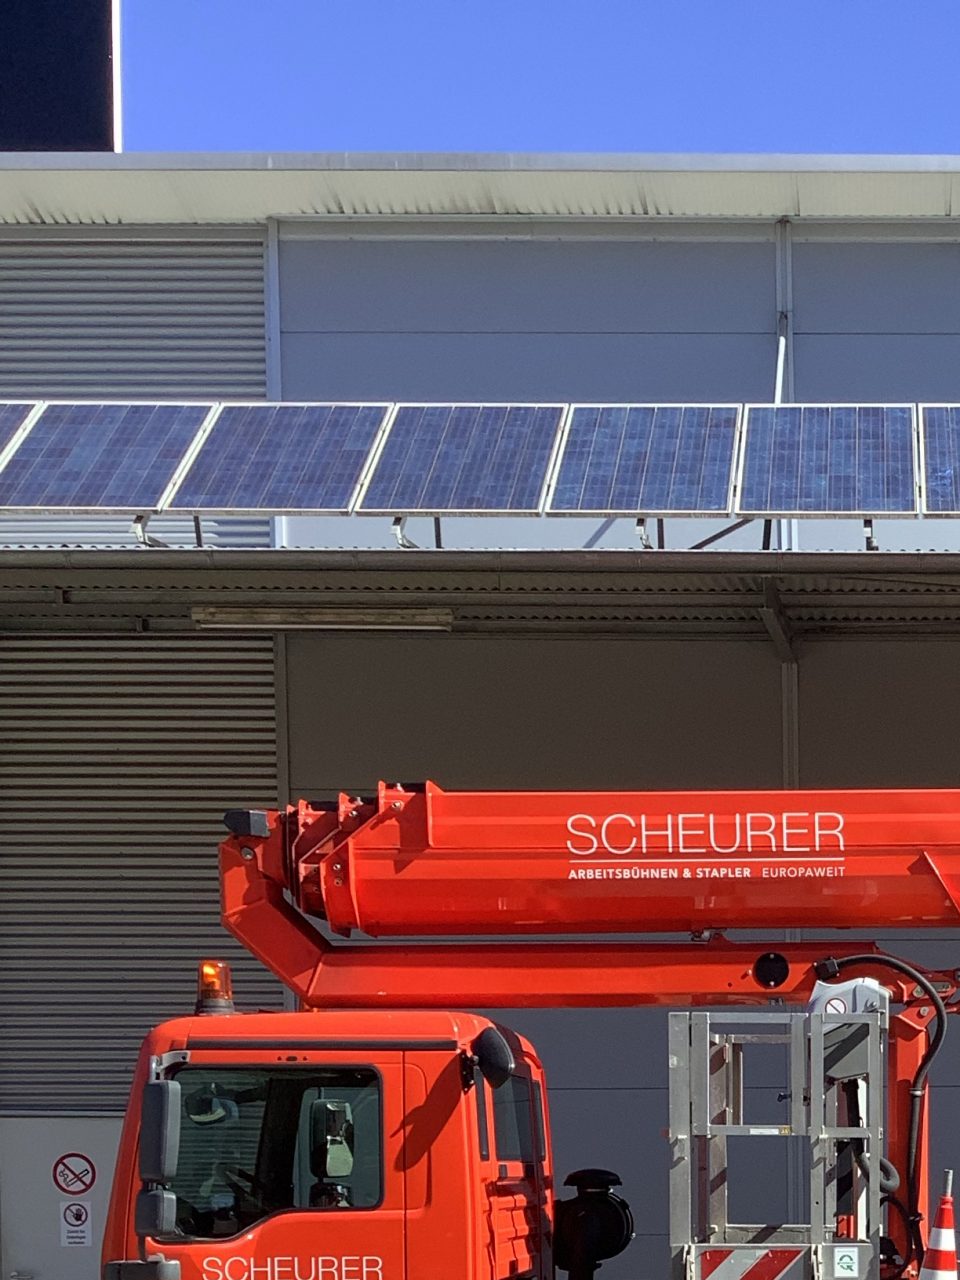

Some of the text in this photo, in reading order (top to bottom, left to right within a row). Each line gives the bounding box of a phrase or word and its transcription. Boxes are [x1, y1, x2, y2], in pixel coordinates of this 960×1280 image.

[566, 812, 846, 855] SCHEURER
[568, 866, 846, 880] ARBEITSBÜHNEN & STAPLER EUROPAWEIT
